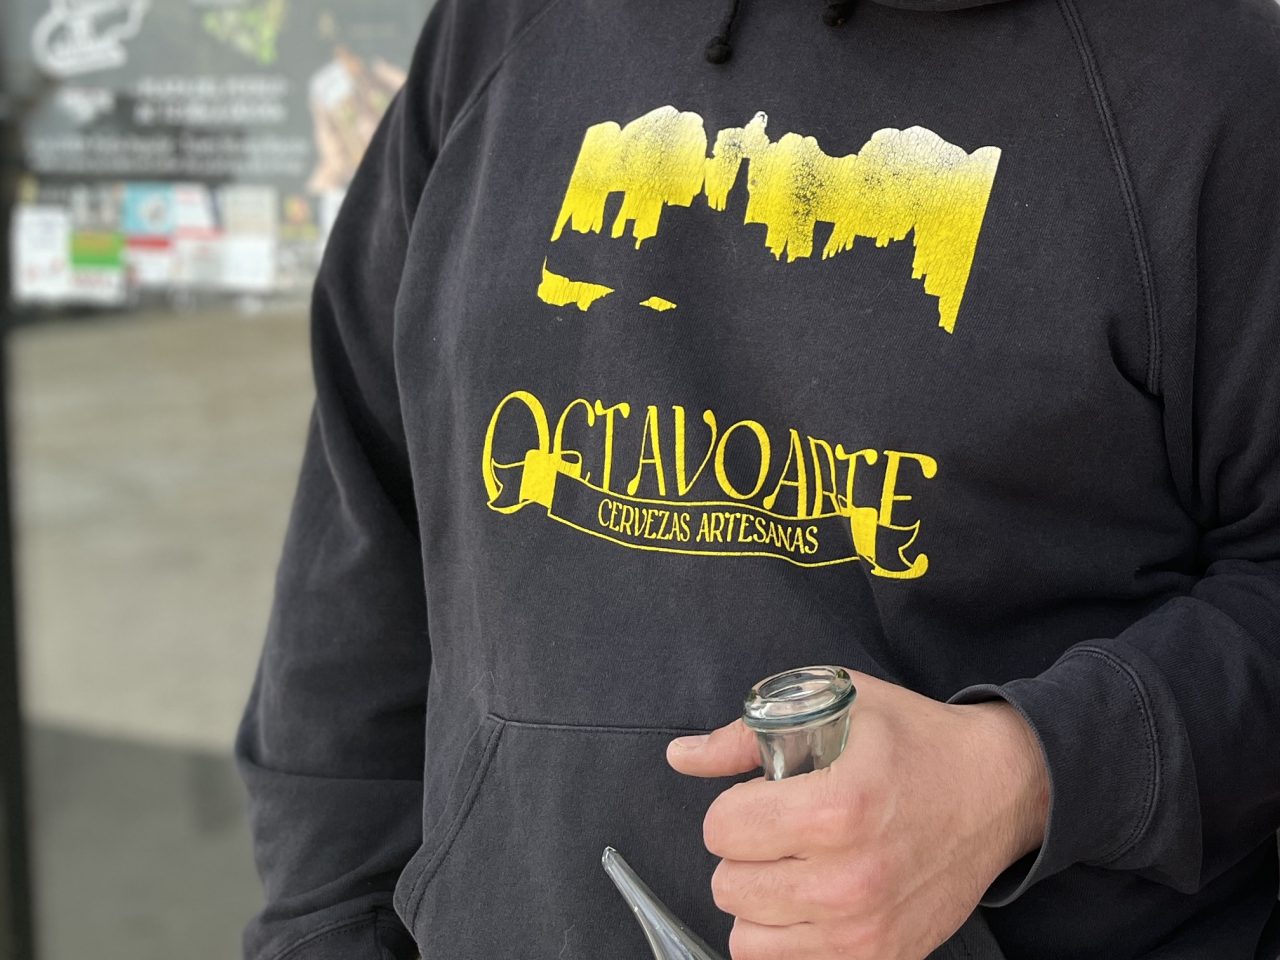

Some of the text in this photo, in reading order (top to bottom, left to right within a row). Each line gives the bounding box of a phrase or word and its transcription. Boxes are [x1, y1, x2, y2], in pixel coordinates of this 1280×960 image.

[481, 390, 938, 580] OCTAVOARTE
[598, 498, 818, 555] CERVEZAS ARTESANAS
